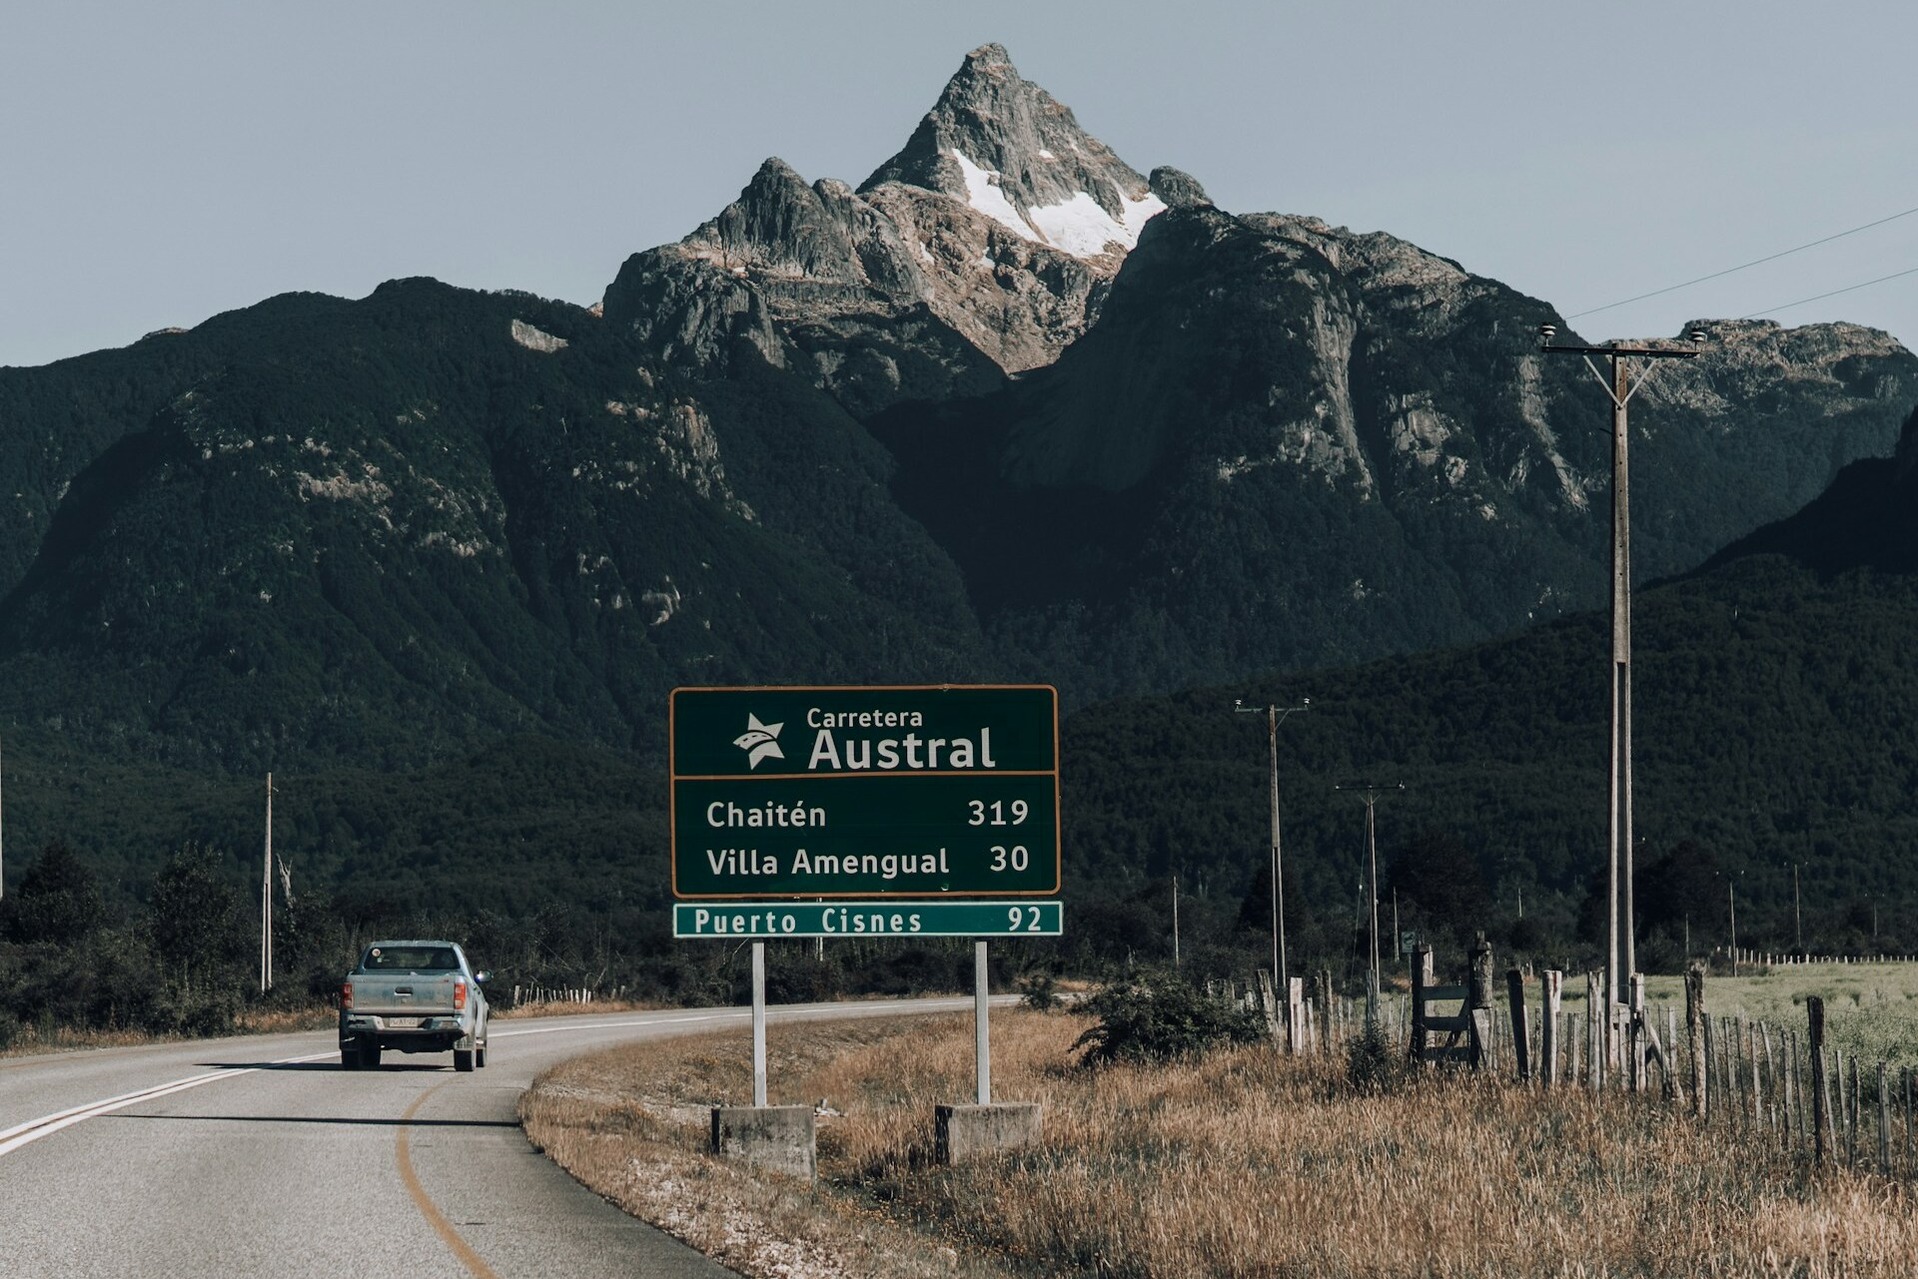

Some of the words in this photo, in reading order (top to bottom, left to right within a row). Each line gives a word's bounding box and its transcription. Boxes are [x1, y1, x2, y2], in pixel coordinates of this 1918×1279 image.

[807, 708, 923, 727] Carretera
[808, 727, 996, 770] Austral
[707, 801, 826, 828] Chaitén
[968, 800, 1029, 826] 319
[707, 848, 778, 875] Villa
[791, 848, 950, 880] Amengual
[990, 845, 1029, 872] 30
[695, 909, 796, 934] Puerto
[822, 907, 922, 933] Cisnes
[1008, 906, 1042, 932] 92
